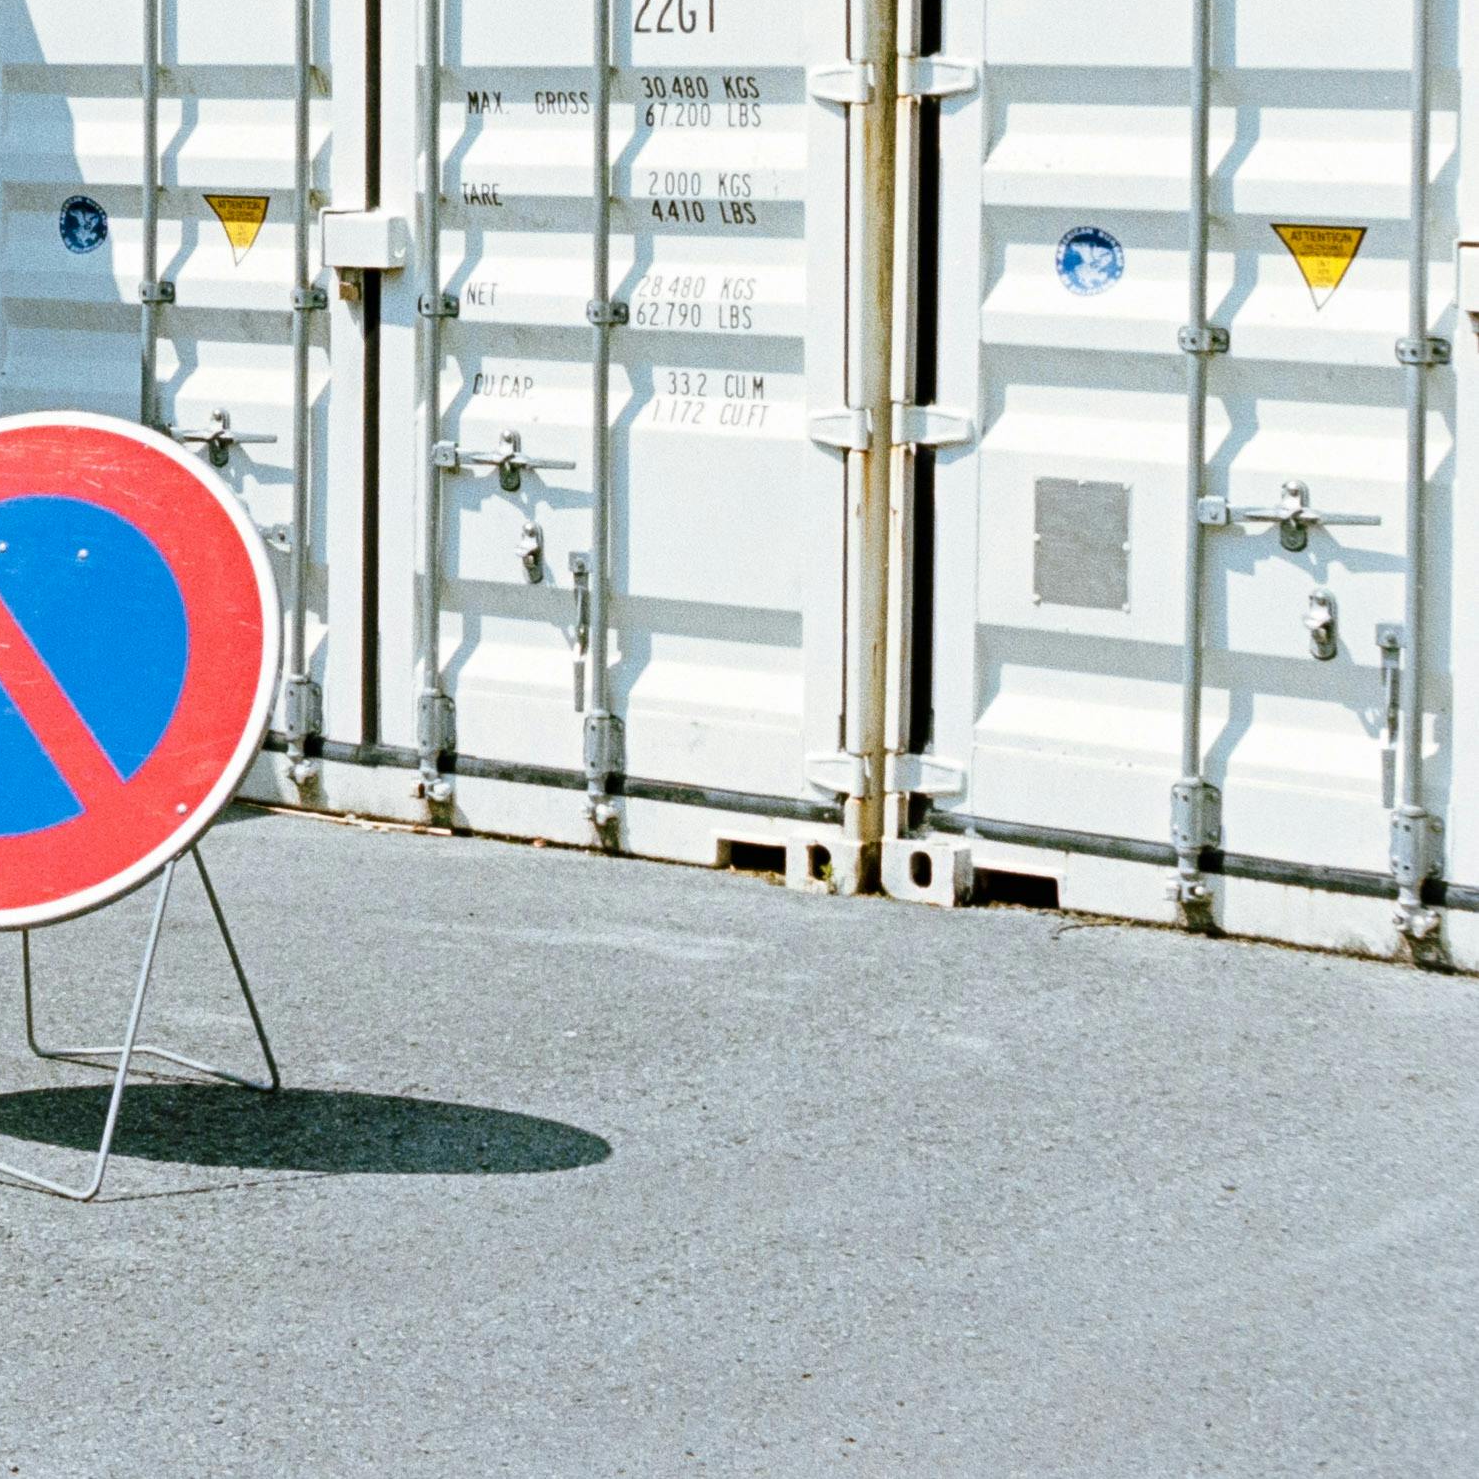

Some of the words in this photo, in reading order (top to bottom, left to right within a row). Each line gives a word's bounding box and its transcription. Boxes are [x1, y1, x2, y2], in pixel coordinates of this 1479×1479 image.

[641, 76, 709, 100] 30.480
[723, 77, 761, 100] KGS
[467, 91, 510, 116] MAX.
[534, 91, 591, 116] GROSS
[644, 103, 711, 128] 67.200
[727, 105, 762, 129] LBS
[461, 182, 504, 207] TARE
[718, 173, 752, 198] KGS
[650, 200, 706, 224] 4.410
[720, 201, 757, 225] LBS
[466, 281, 499, 307] NET
[720, 277, 758, 301] KGS
[635, 303, 702, 328] 62.790
[718, 304, 753, 330] LBS
[667, 372, 708, 397] 33.2
